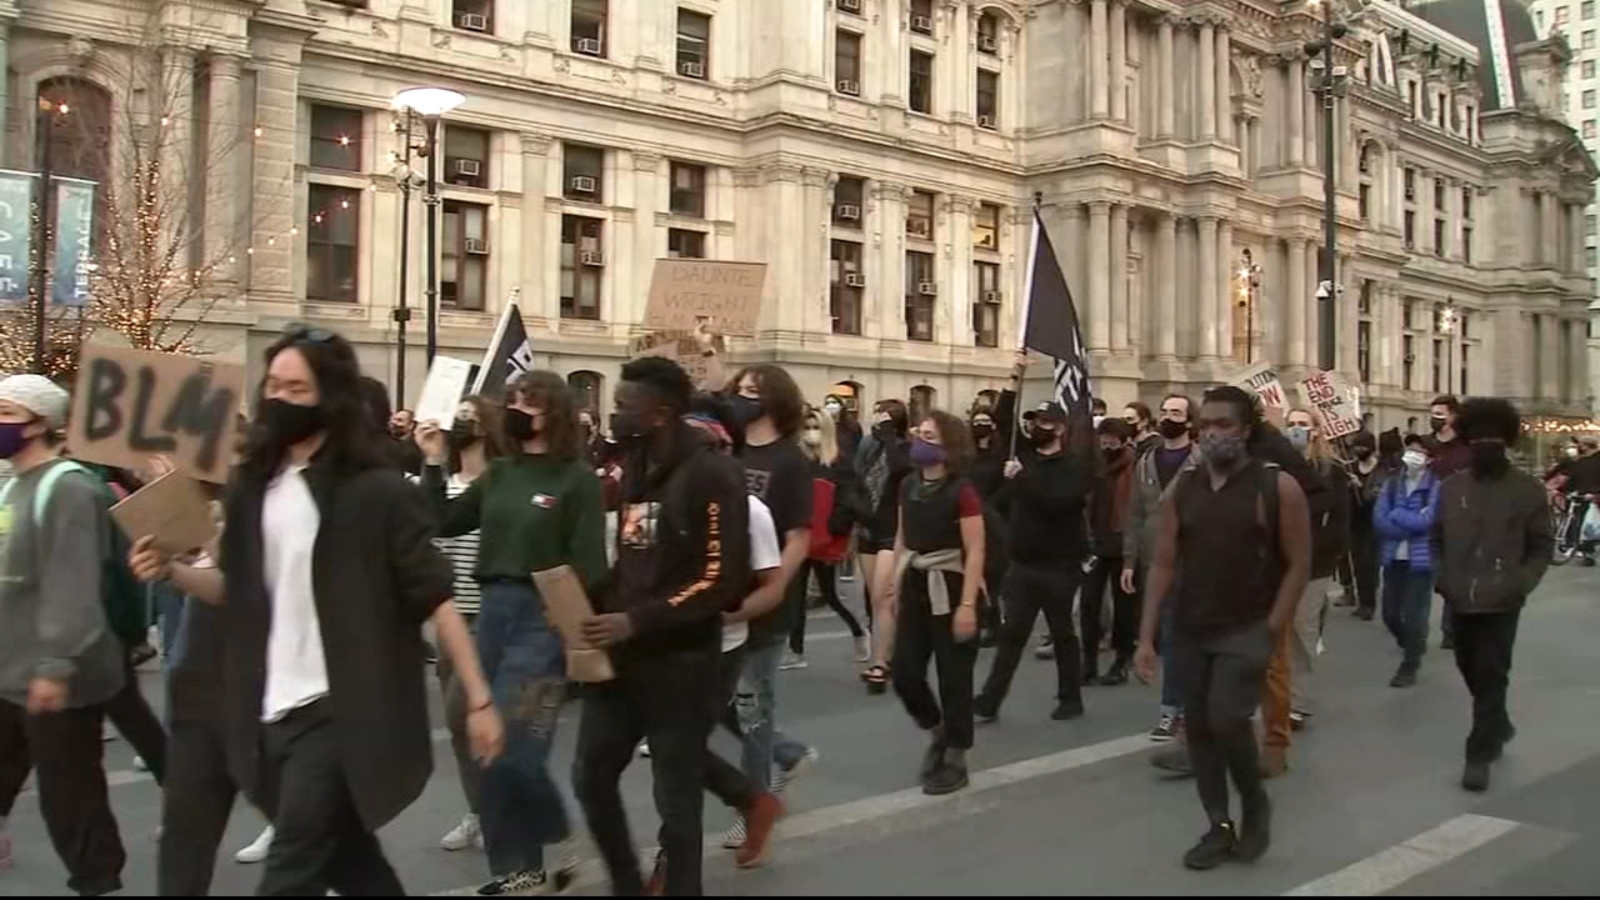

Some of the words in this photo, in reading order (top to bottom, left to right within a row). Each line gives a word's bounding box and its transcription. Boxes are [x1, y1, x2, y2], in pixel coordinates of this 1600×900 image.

[670, 266, 760, 287] DAUNTE
[1302, 373, 1330, 390] THE
[1308, 385, 1335, 403] END
[85, 358, 232, 473] BLM
